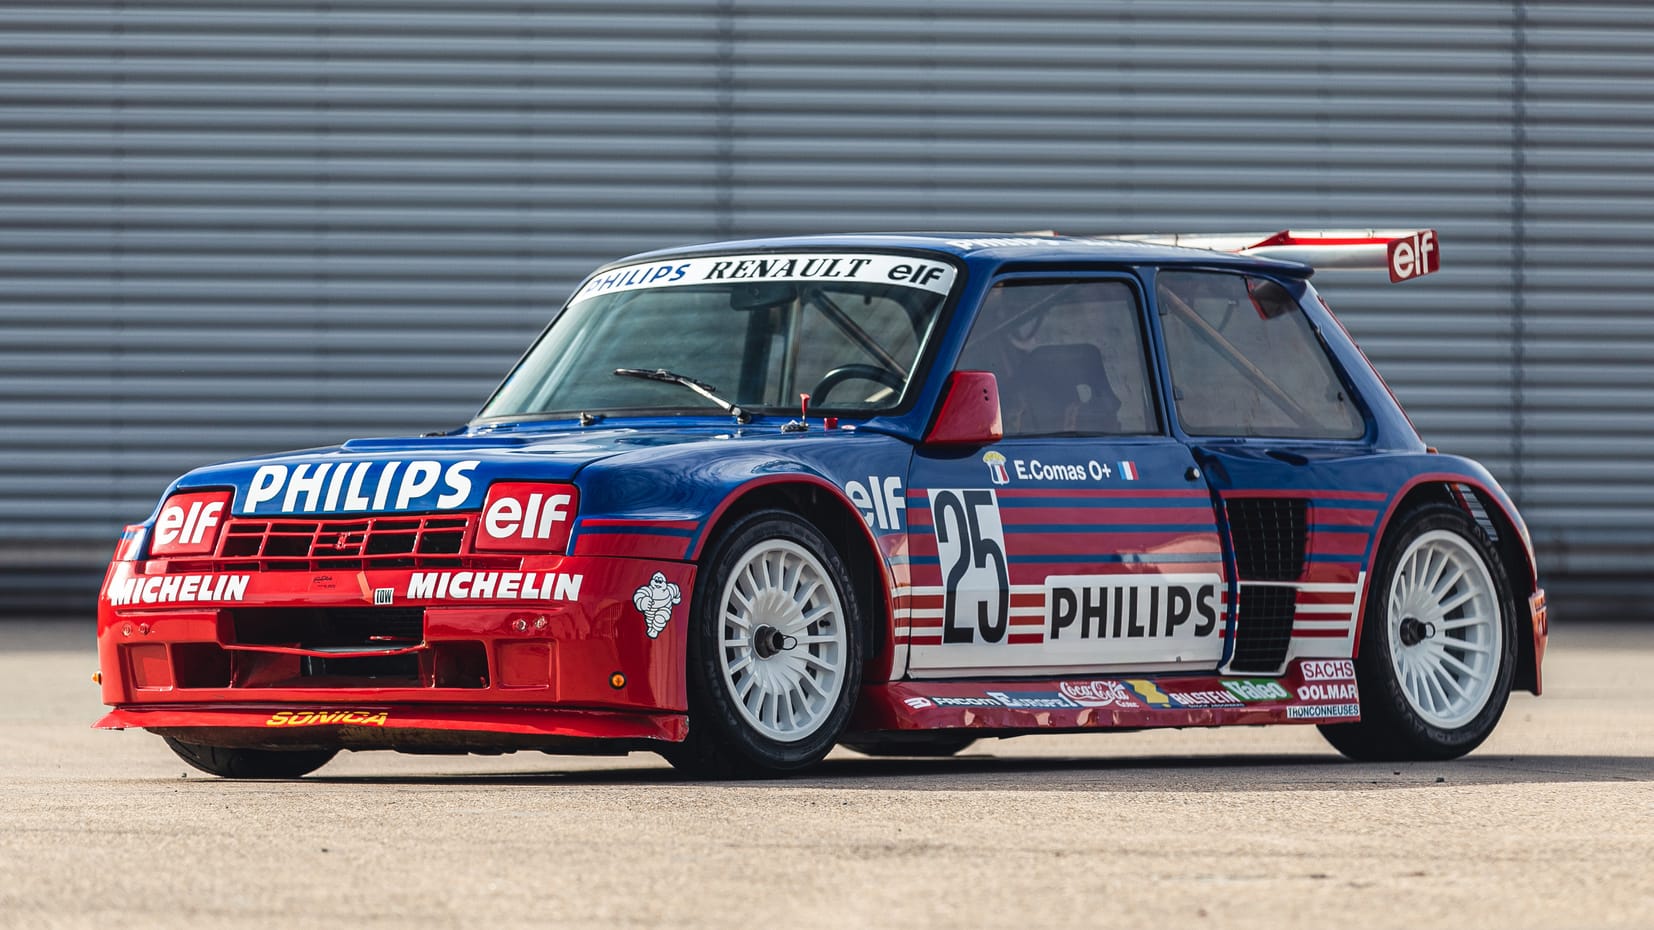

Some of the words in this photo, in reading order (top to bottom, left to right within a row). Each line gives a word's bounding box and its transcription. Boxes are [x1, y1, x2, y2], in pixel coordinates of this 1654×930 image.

[703, 258, 872, 281] RENAULT
[1393, 231, 1434, 279] elf
[586, 264, 691, 293] PHILIPS
[887, 264, 945, 287] elf
[1013, 459, 1087, 481] E.Comas
[1088, 460, 1112, 481] O+
[243, 460, 481, 513] PHILIPS
[485, 493, 571, 540] elf
[845, 476, 906, 530] elf
[154, 501, 225, 545] elf
[933, 489, 1010, 645] 25
[109, 575, 250, 606] MICHELIN
[376, 589, 393, 603] TOW
[407, 571, 584, 602] MICHELIN
[1051, 584, 1217, 640] PHILIPS
[1303, 662, 1354, 678] SACHS
[1169, 690, 1241, 705] BILSTEIN
[1297, 684, 1357, 700] DOLMAR
[266, 711, 388, 726] SONICA
